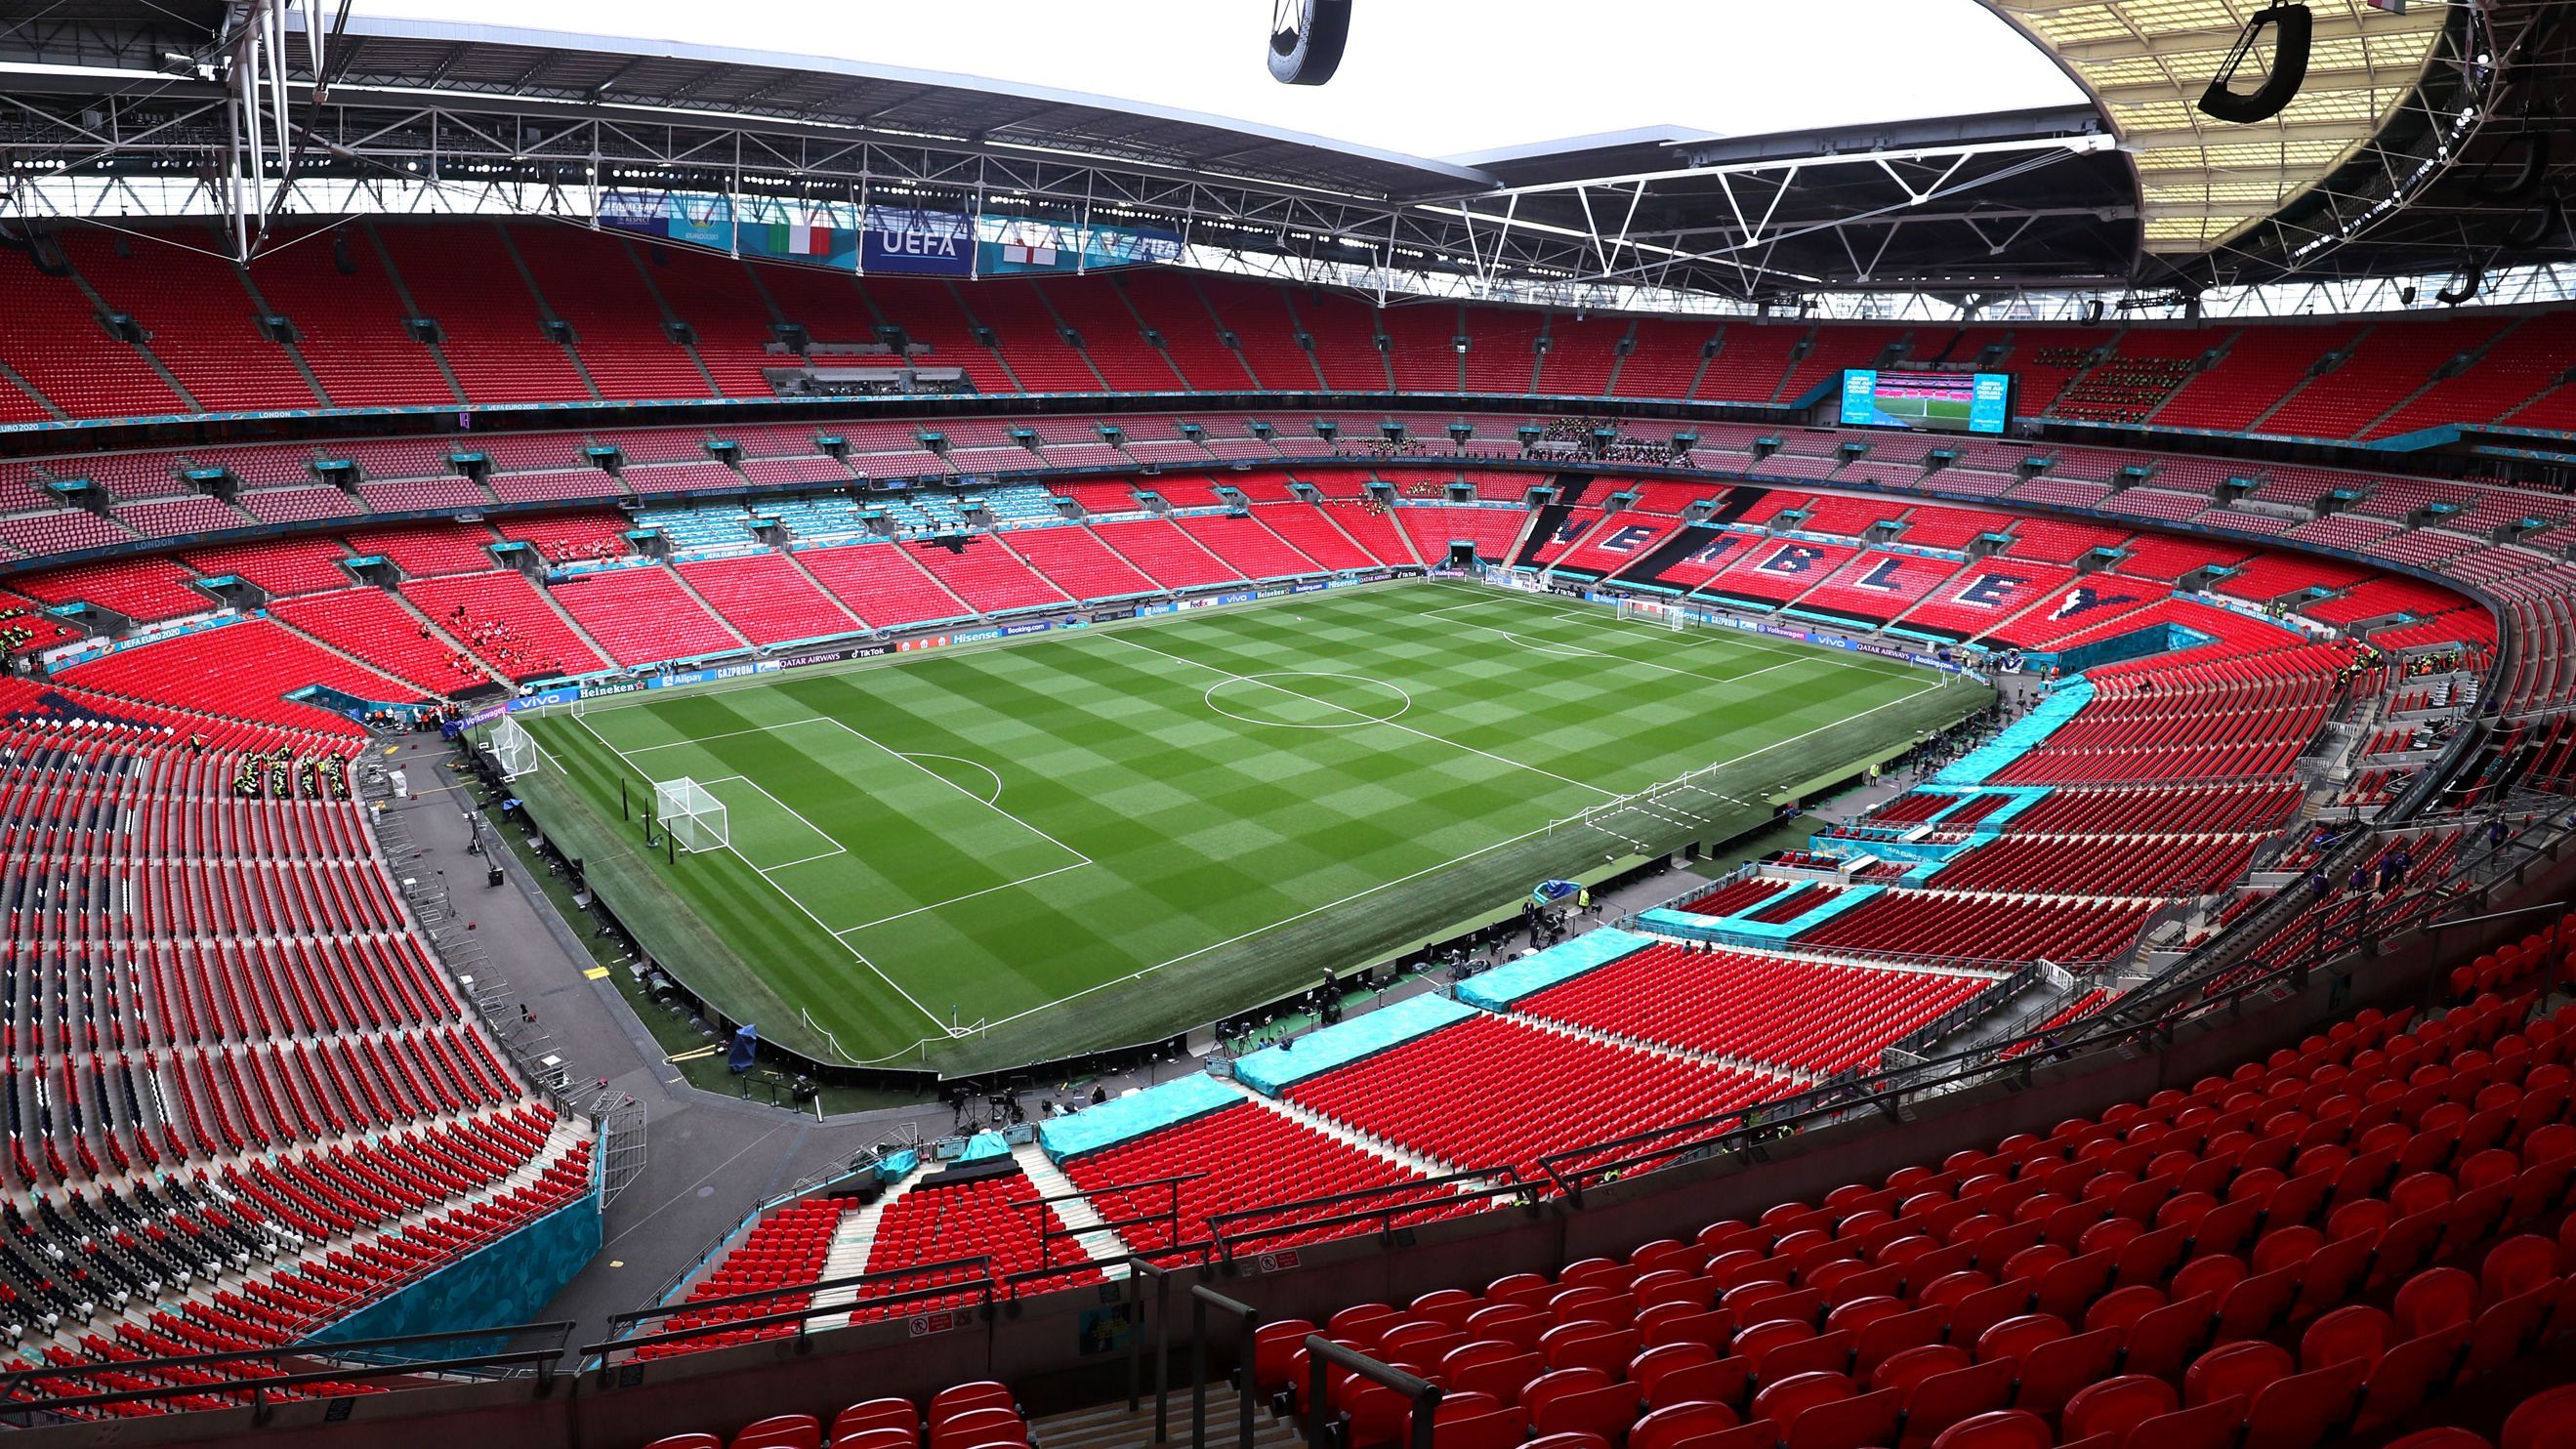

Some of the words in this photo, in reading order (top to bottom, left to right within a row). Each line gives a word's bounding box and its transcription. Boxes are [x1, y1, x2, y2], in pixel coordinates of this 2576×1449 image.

[882, 229, 957, 256] UEFA
[1142, 236, 1178, 254] FIFA
[259, 410, 292, 419] LONDON
[0, 423, 19, 433] URO
[2164, 520, 2192, 529] LONDON
[136, 537, 175, 551] LONDON
[1328, 578, 1357, 588] Hisense
[1226, 594, 1247, 602] vivo
[1257, 591, 1285, 600] Heineken
[1600, 595, 1617, 604] Alipay
[1152, 605, 1170, 615] Alipay
[1189, 600, 1208, 608] FedEx
[2229, 603, 2243, 613] UEFA
[2243, 606, 2256, 616] EURO
[2257, 611, 2269, 621] 2020
[1007, 623, 1045, 635] Booking.com
[1766, 625, 1805, 639] Volkswagen
[120, 639, 142, 649] UEFA
[142, 632, 161, 644] EURO
[161, 627, 181, 640] 2020
[953, 630, 999, 644] Hisense
[1817, 636, 1846, 647] vivo
[860, 646, 885, 656] TikTok
[1856, 642, 1879, 653] QATAR
[1880, 647, 1910, 660] AIRWAYS
[779, 657, 806, 669] QATAR
[808, 652, 841, 665] AIRWAYS
[1915, 655, 1954, 671] Booking.com
[674, 672, 702, 684] Alipay
[717, 665, 754, 679] GAZPROM
[580, 683, 635, 699] Heineken
[519, 694, 560, 708] vivo
[465, 705, 506, 726] Volkswagen
[1884, 846, 1901, 855] UEFA
